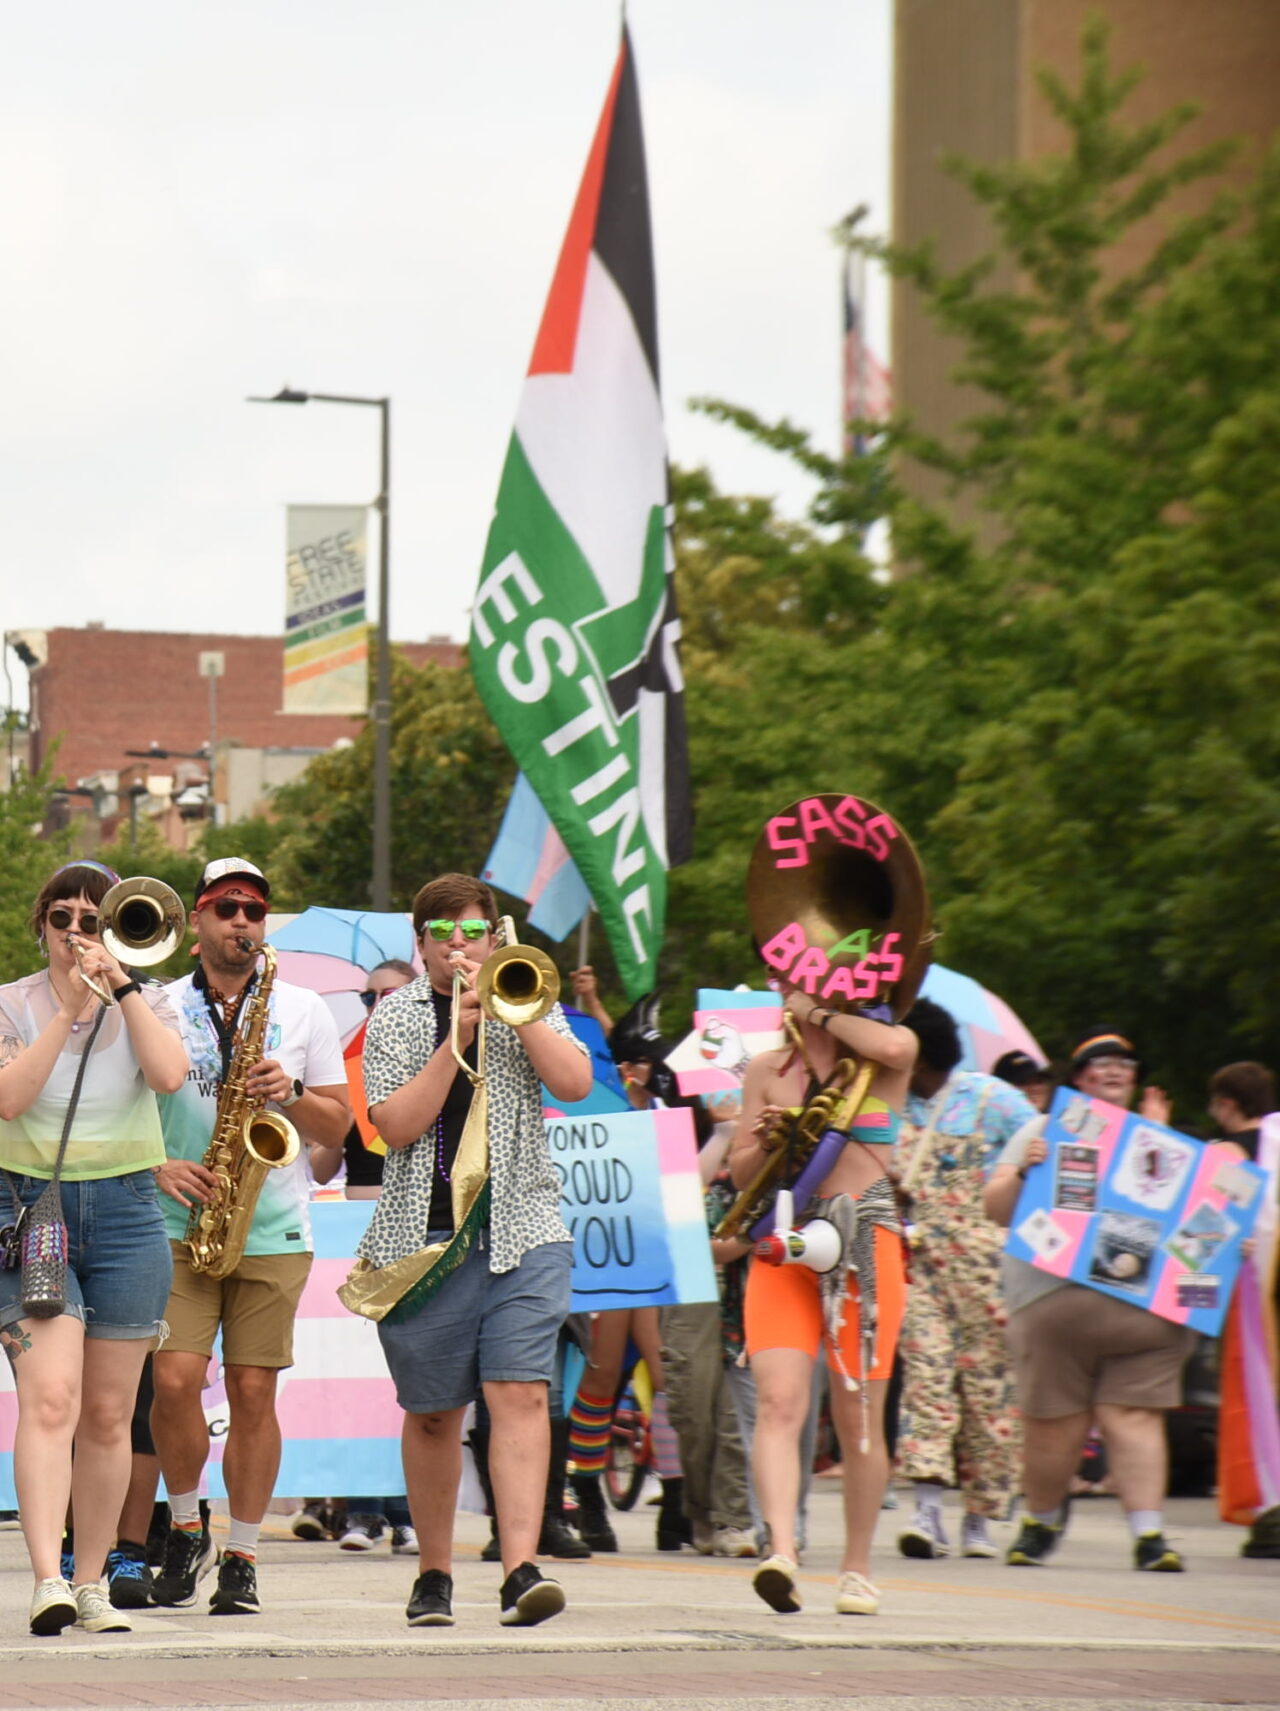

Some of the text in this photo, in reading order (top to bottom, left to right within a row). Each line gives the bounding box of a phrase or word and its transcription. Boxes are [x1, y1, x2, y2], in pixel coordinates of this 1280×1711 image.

[286, 530, 358, 576] FREE
[289, 552, 365, 595] STATE
[766, 794, 900, 868] SASS
[761, 922, 904, 1000] BRASS
[196, 1082, 218, 1098] Wa
